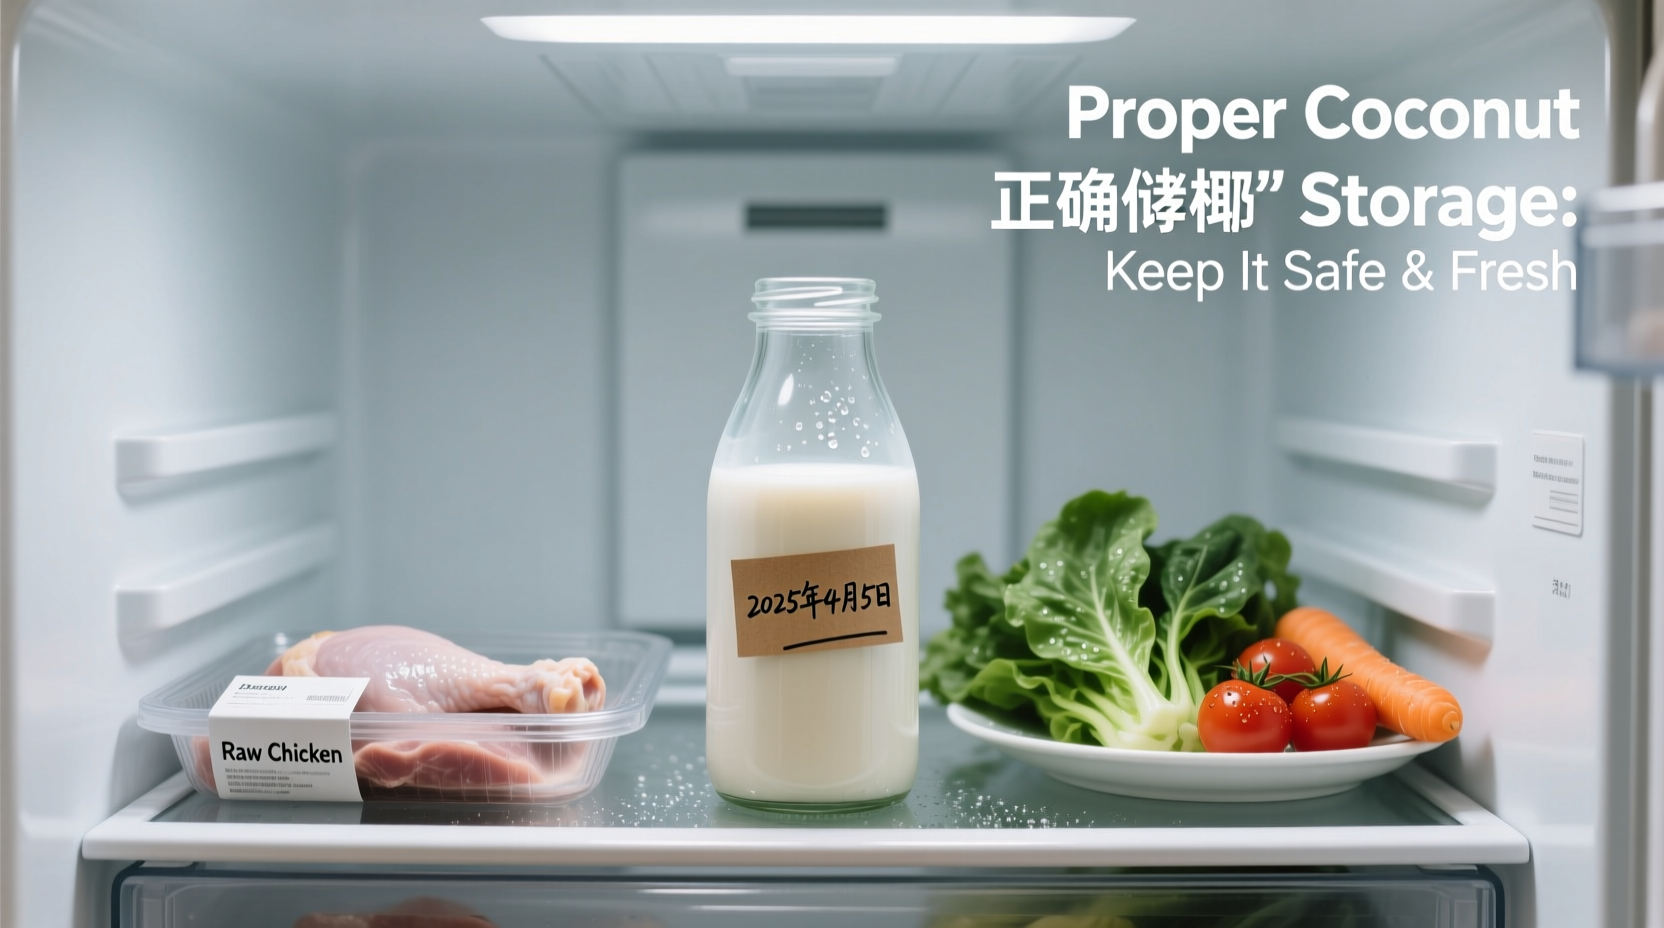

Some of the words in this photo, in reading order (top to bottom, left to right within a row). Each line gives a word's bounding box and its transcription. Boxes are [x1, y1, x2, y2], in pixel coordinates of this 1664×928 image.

[747, 580, 891, 620] 2025年4月5日
[221, 741, 262, 762] Raw
[267, 741, 343, 763] Chicken
